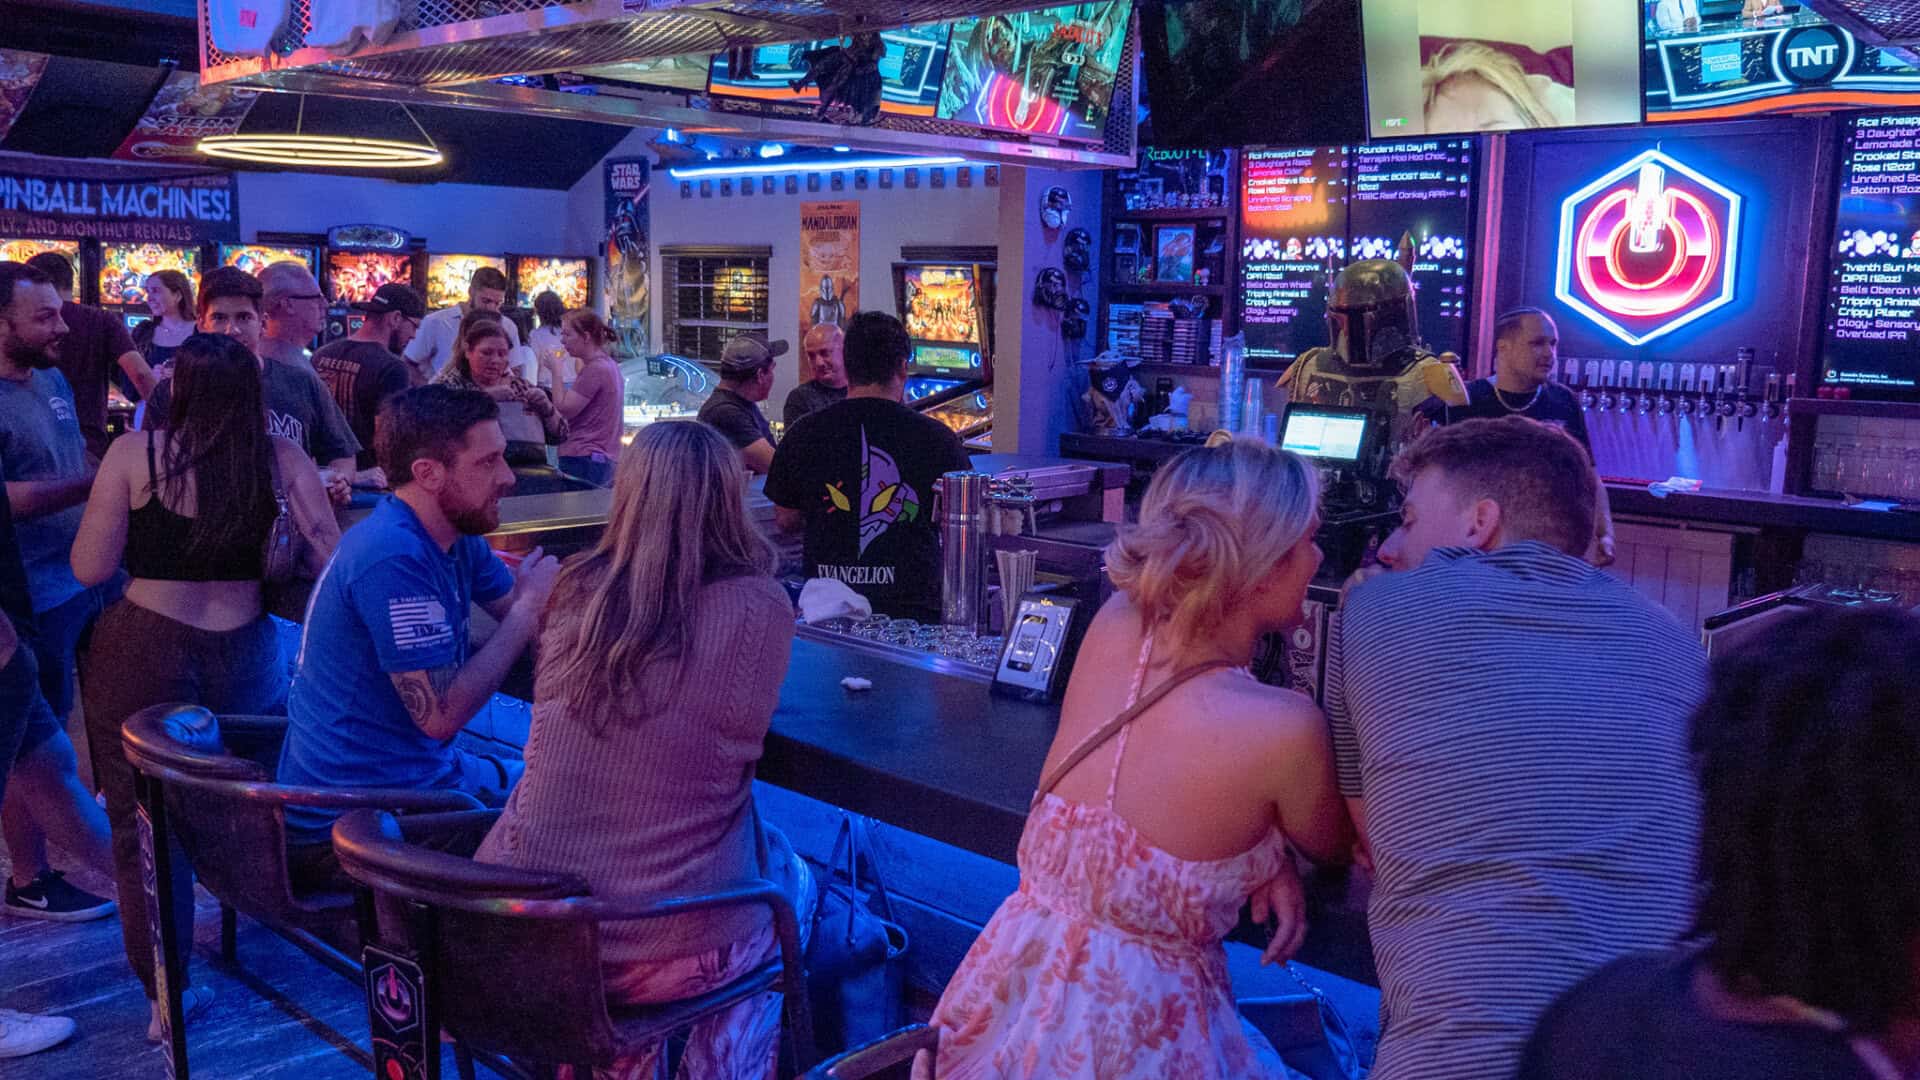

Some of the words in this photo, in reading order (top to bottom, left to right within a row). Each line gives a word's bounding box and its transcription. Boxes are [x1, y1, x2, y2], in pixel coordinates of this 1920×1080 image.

[1785, 44, 1839, 68] TNT
[1358, 146, 1394, 154] Founders
[1406, 144, 1422, 153] Day
[1855, 139, 1913, 149] Lemonade
[1853, 151, 1900, 161] Crooked
[611, 163, 640, 177] STAR
[1852, 163, 1881, 173] Rose
[611, 176, 640, 190] WARS
[1851, 173, 1905, 184] Unrefined
[1850, 185, 1890, 195] Bottom
[0, 176, 96, 215] INBALL
[102, 182, 231, 221] MACHINES!
[801, 215, 858, 231] MANDALORIAN
[26, 218, 57, 235] AND
[62, 220, 129, 238] MONTHLY
[135, 223, 193, 241] RENTALS
[1882, 263, 1905, 272] Sun
[1840, 285, 1868, 294] Bells
[1869, 286, 1910, 295] Oberon
[1839, 296, 1882, 308] Tripping
[1838, 307, 1873, 318] Crippy
[1874, 307, 1914, 318] Pilsner
[1836, 329, 1886, 339] Overload
[1887, 330, 1907, 340] IPA
[817, 564, 896, 584] EVANGELION
